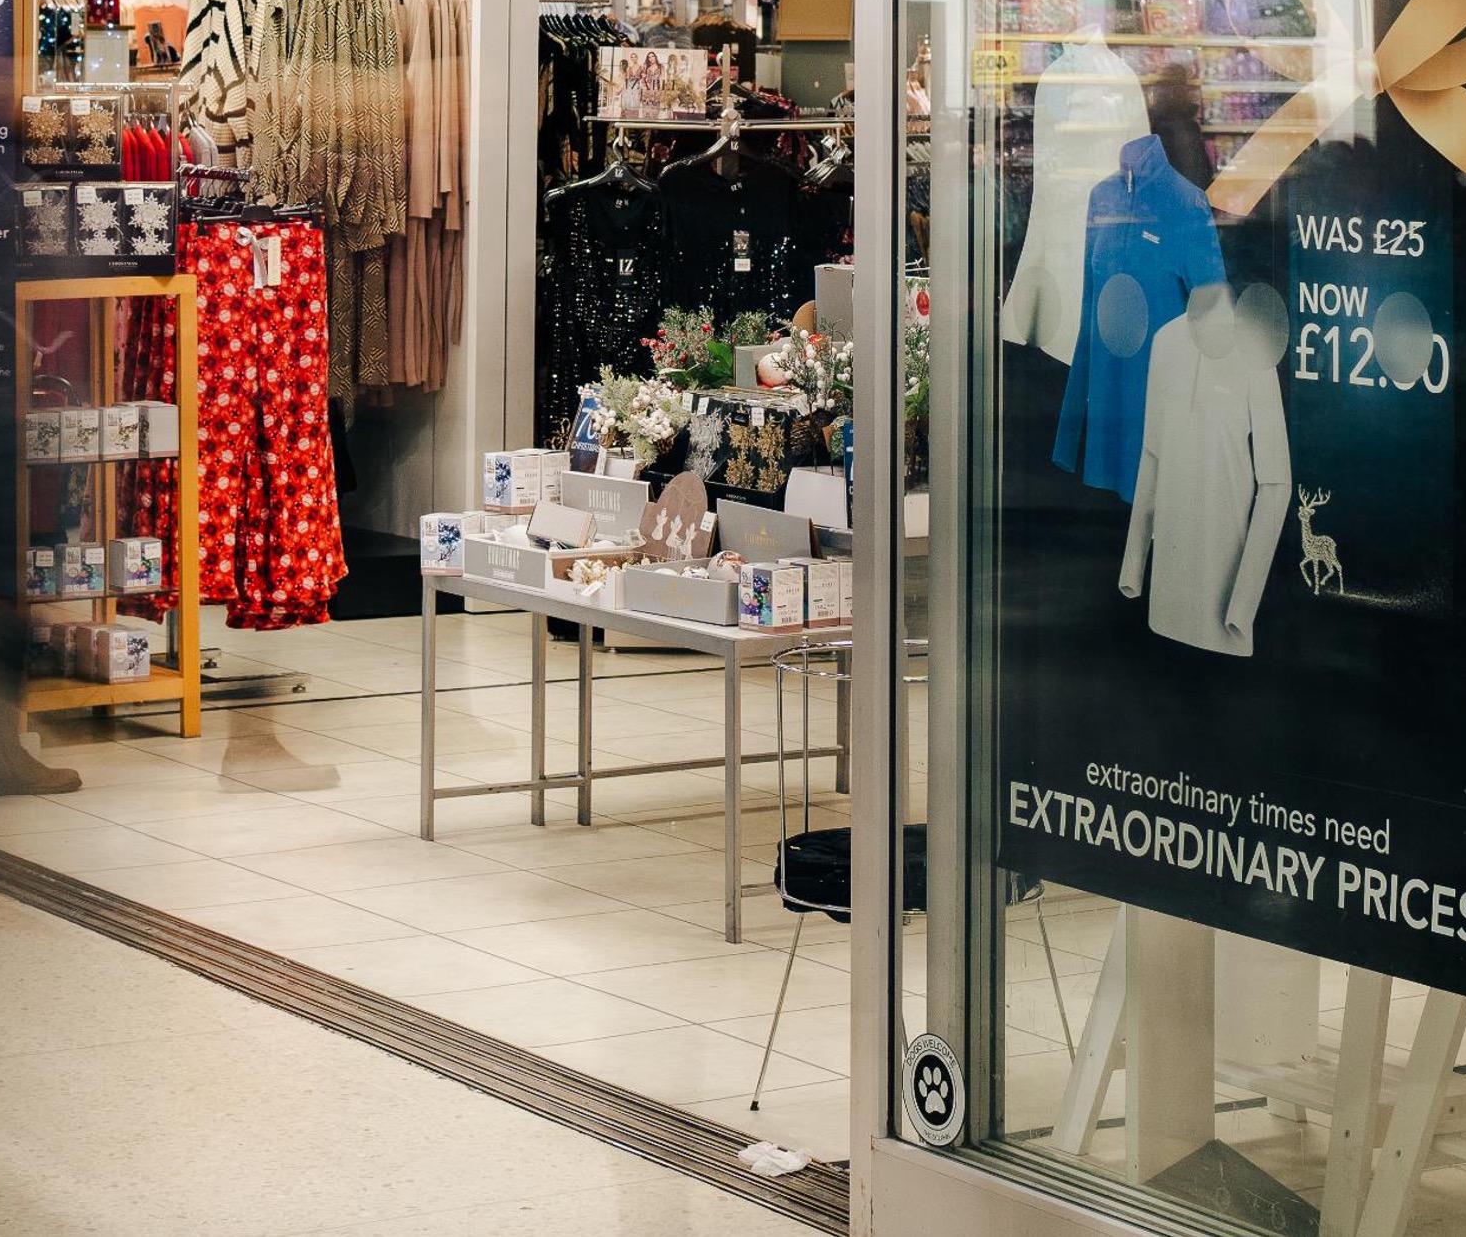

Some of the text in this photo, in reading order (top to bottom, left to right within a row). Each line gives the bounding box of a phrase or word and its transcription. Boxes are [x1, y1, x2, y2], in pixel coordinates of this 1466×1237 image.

[1296, 214, 1427, 257] WAS £25
[1299, 281, 1369, 318] NOW
[1009, 780, 1326, 903] EXTRAORDINARY
[1086, 761, 1390, 855] extraordinary times need
